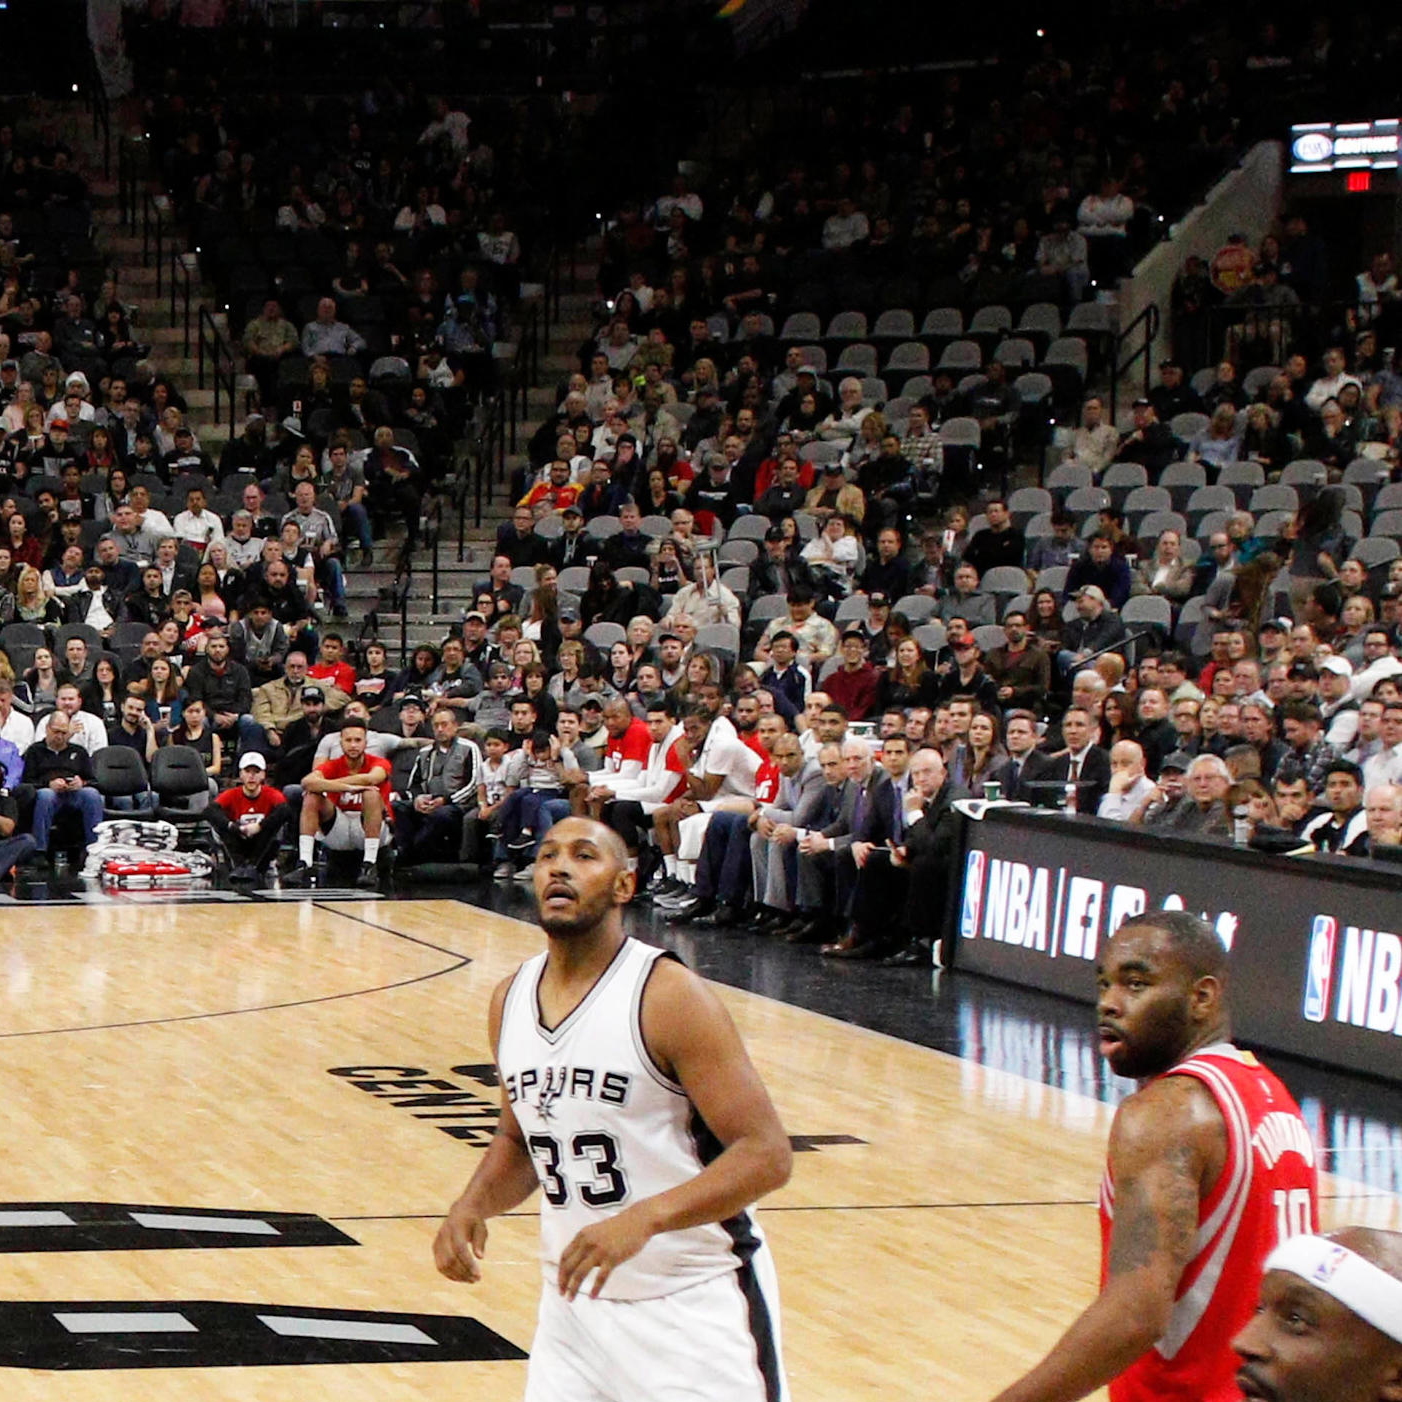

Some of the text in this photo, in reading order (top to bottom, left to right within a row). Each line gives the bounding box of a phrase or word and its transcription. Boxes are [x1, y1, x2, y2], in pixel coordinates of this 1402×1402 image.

[983, 858, 1049, 952] NBA
[1336, 925, 1402, 1038] NB
[526, 1130, 633, 1209] 33
